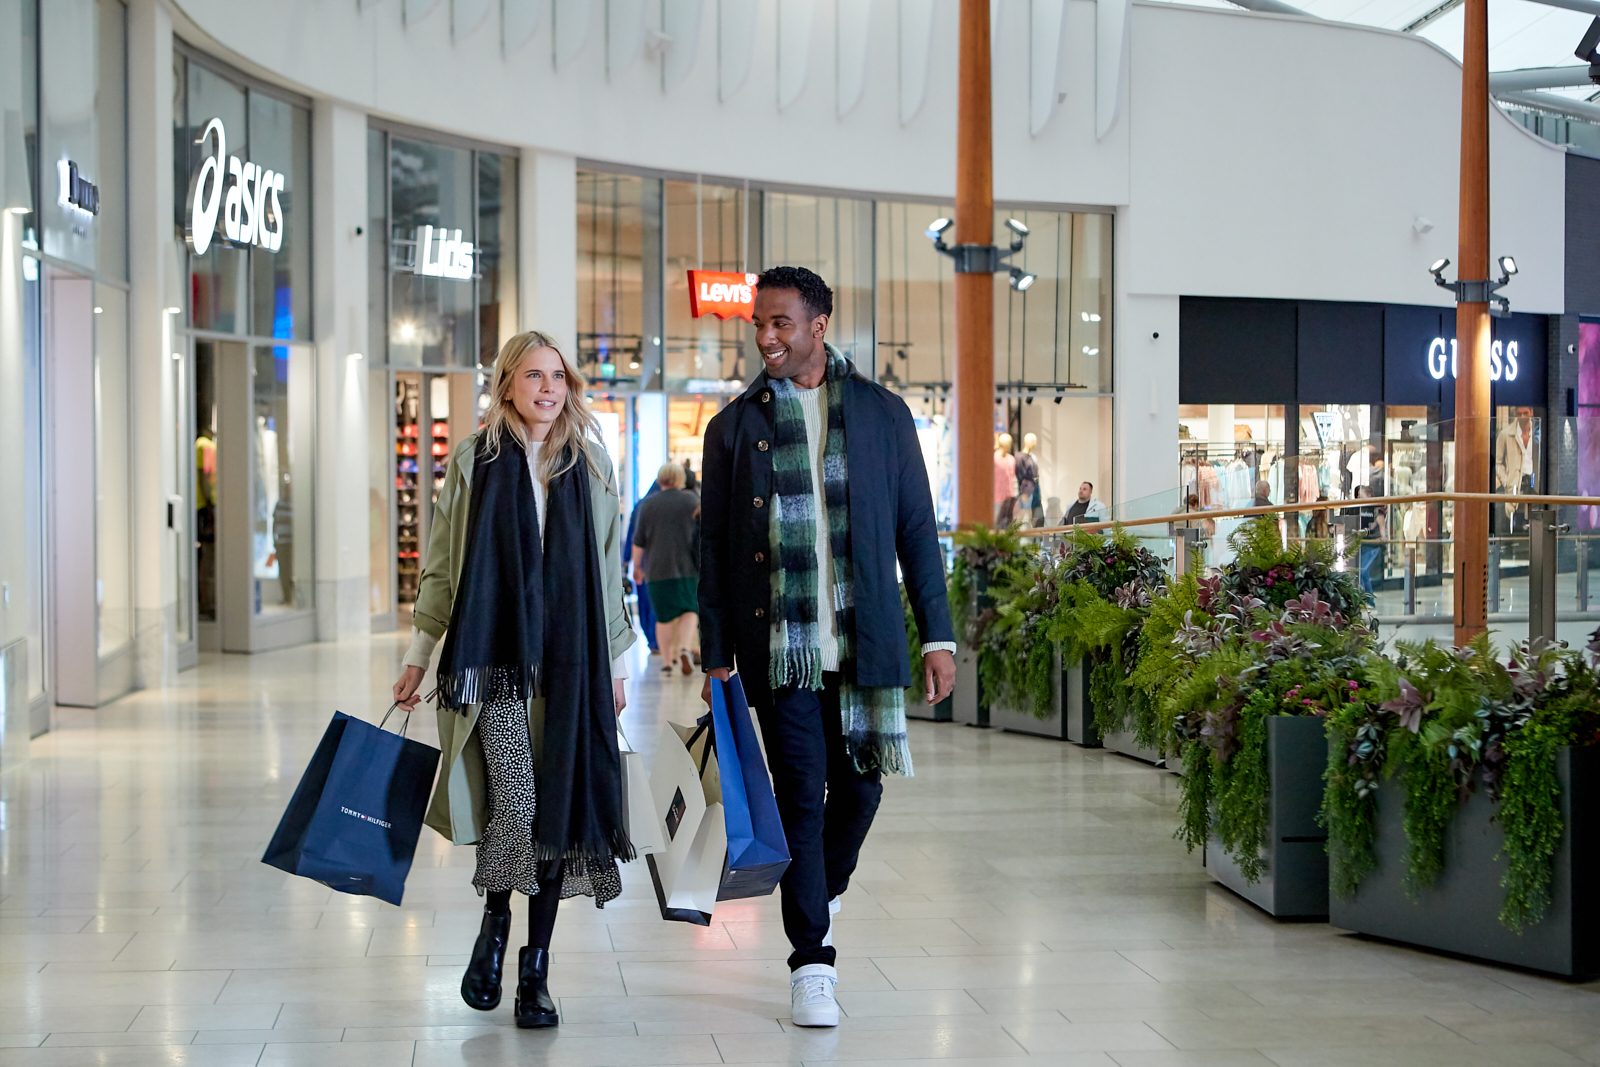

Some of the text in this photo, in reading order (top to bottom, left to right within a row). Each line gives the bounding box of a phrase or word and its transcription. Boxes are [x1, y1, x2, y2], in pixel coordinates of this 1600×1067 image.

[421, 224, 474, 280] Lids
[1428, 337, 1518, 382] GSS
[340, 806, 392, 829] TOMMY HILFIGER
